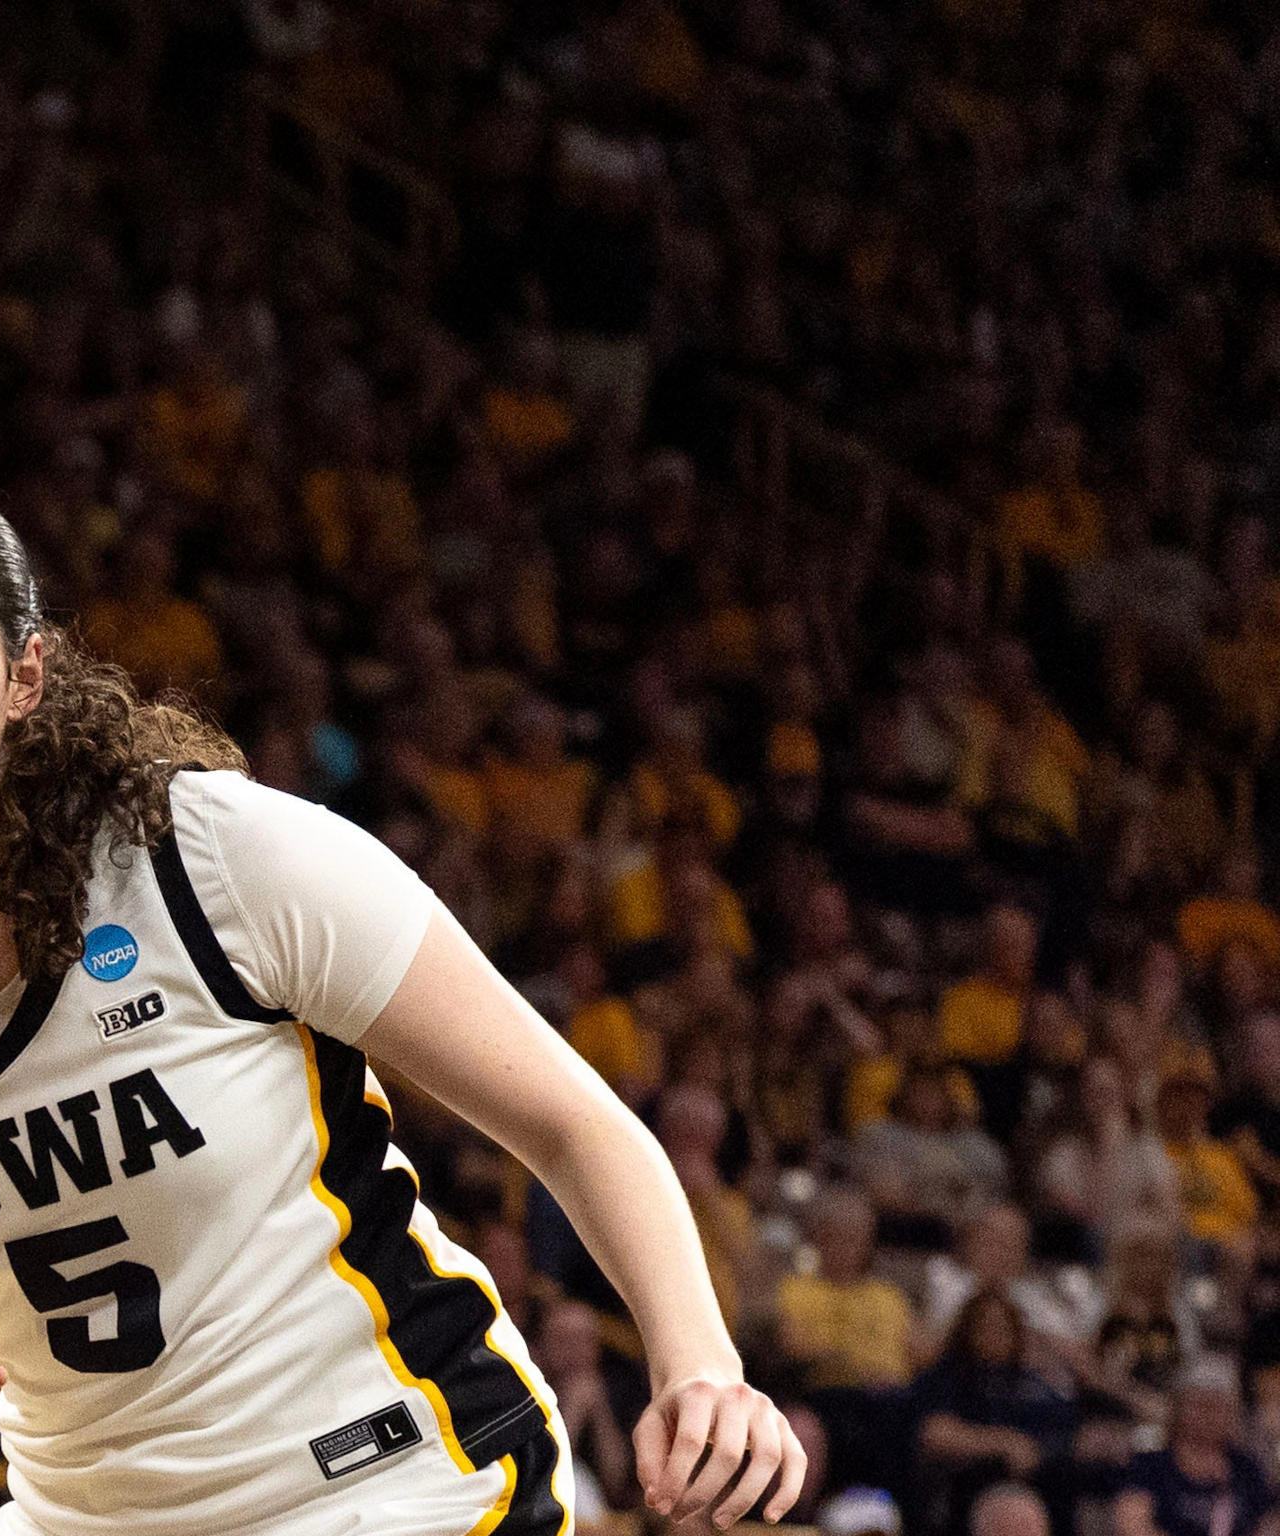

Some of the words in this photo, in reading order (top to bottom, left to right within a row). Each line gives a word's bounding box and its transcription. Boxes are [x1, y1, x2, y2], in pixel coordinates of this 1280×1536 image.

[91, 944, 137, 970] NCAA
[4, 1215, 167, 1375] 5
[317, 1423, 369, 1452] ENGINEERED
[384, 1422, 403, 1440] L
